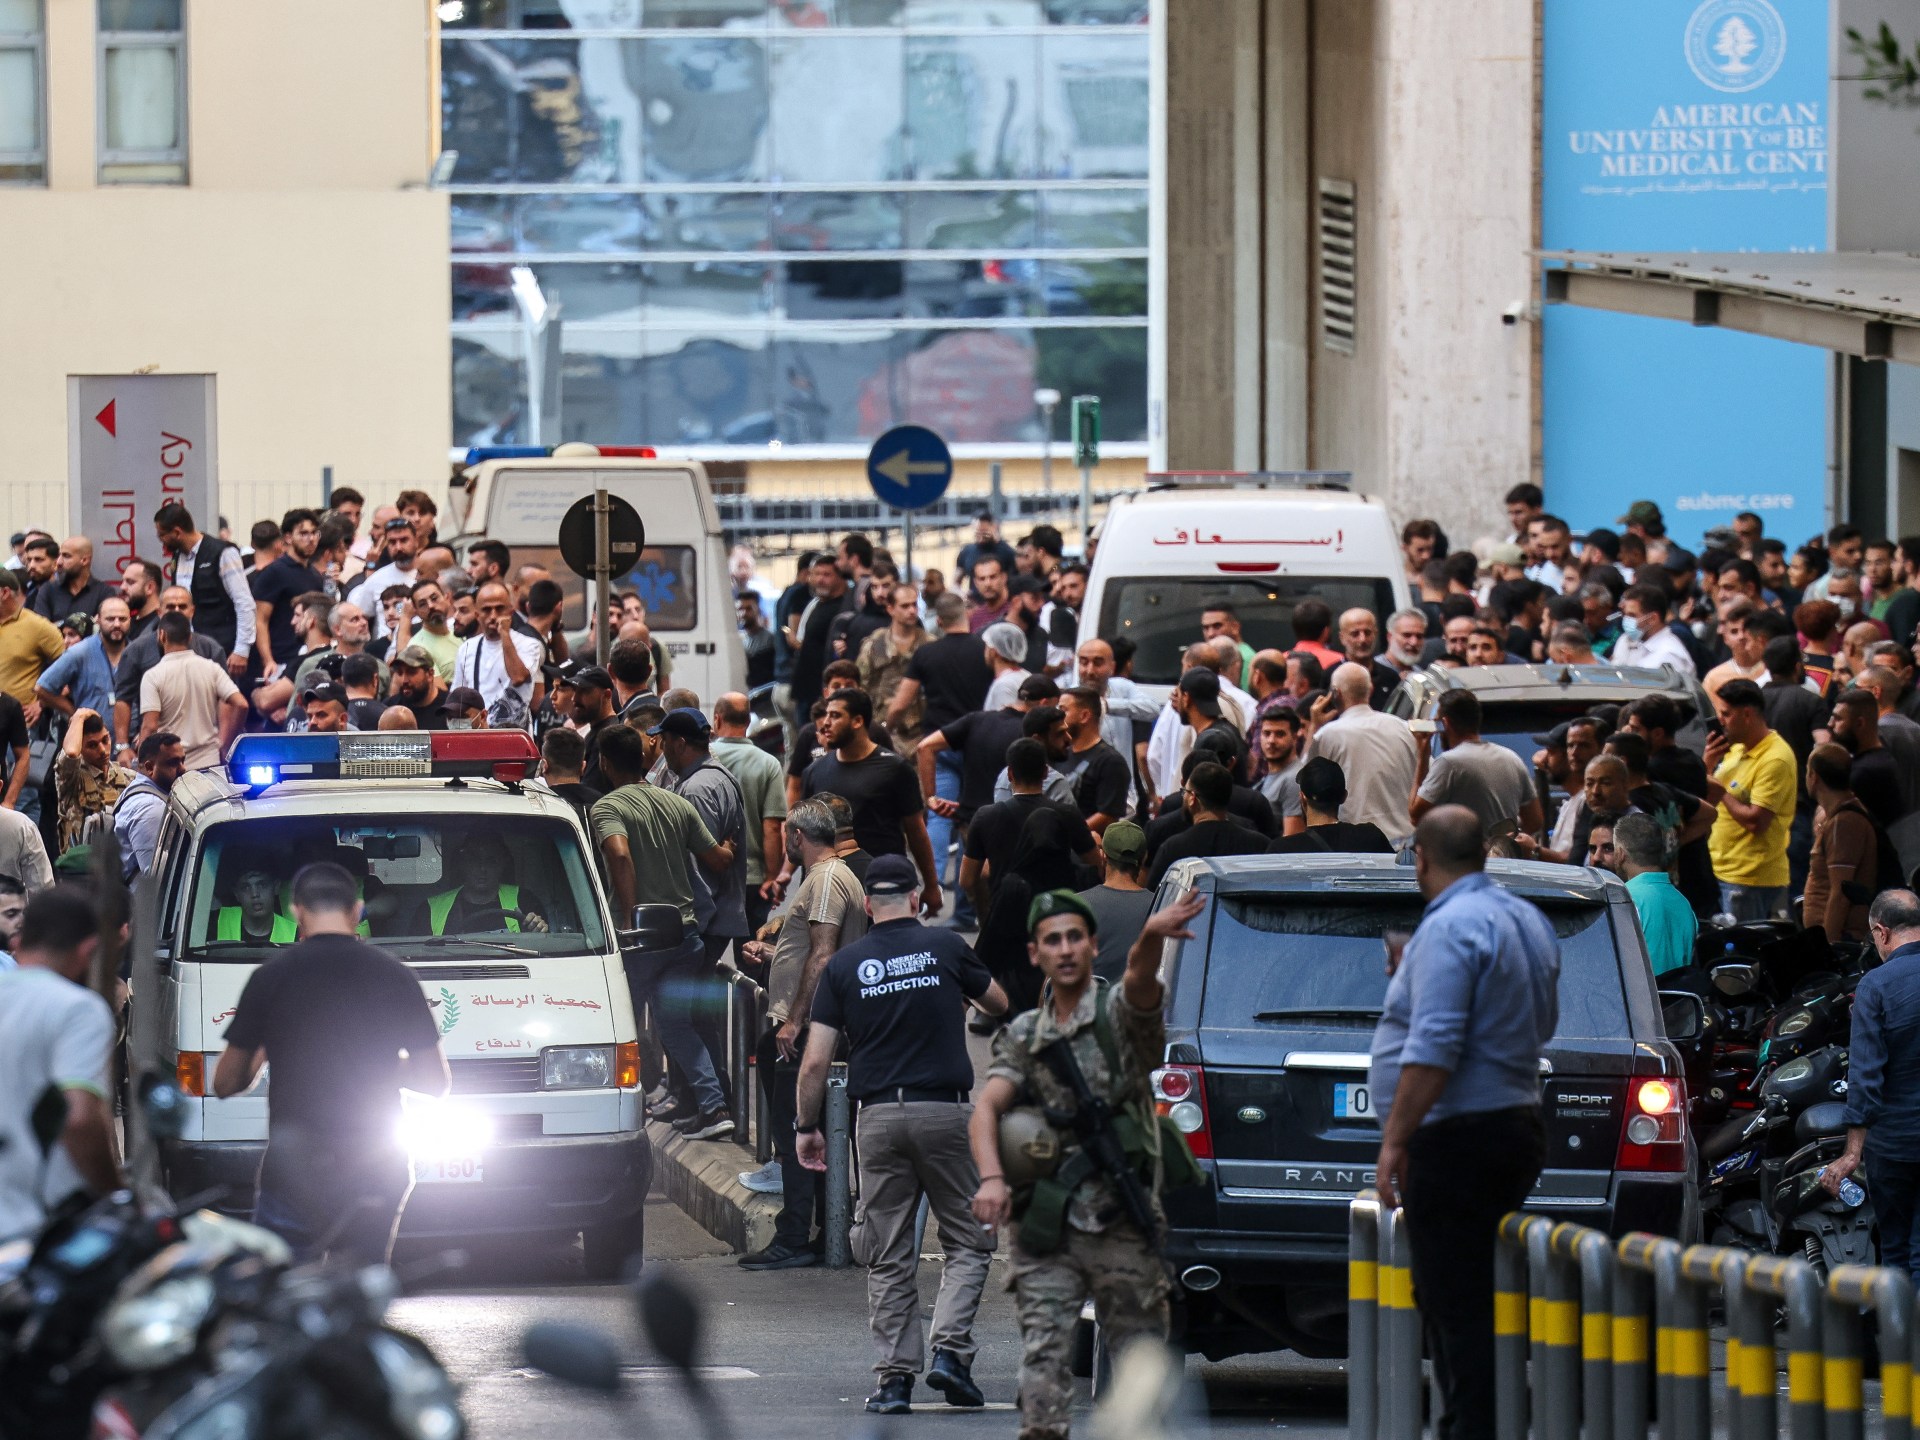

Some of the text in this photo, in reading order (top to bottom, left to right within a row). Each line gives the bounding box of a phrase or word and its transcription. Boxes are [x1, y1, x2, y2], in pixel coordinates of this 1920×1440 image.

[1651, 102, 1819, 128] AMERICAN
[1569, 127, 1760, 154] UNIVERSITY
[1600, 151, 1740, 177] MEDICAL
[1153, 528, 1344, 552] إسعاف
[886, 951, 931, 965] AMERICAN
[860, 975, 940, 999] PROTECTION
[470, 994, 535, 1009] الرسالة
[543, 993, 602, 1013] جمعية
[1557, 1094, 1613, 1104] SPORT
